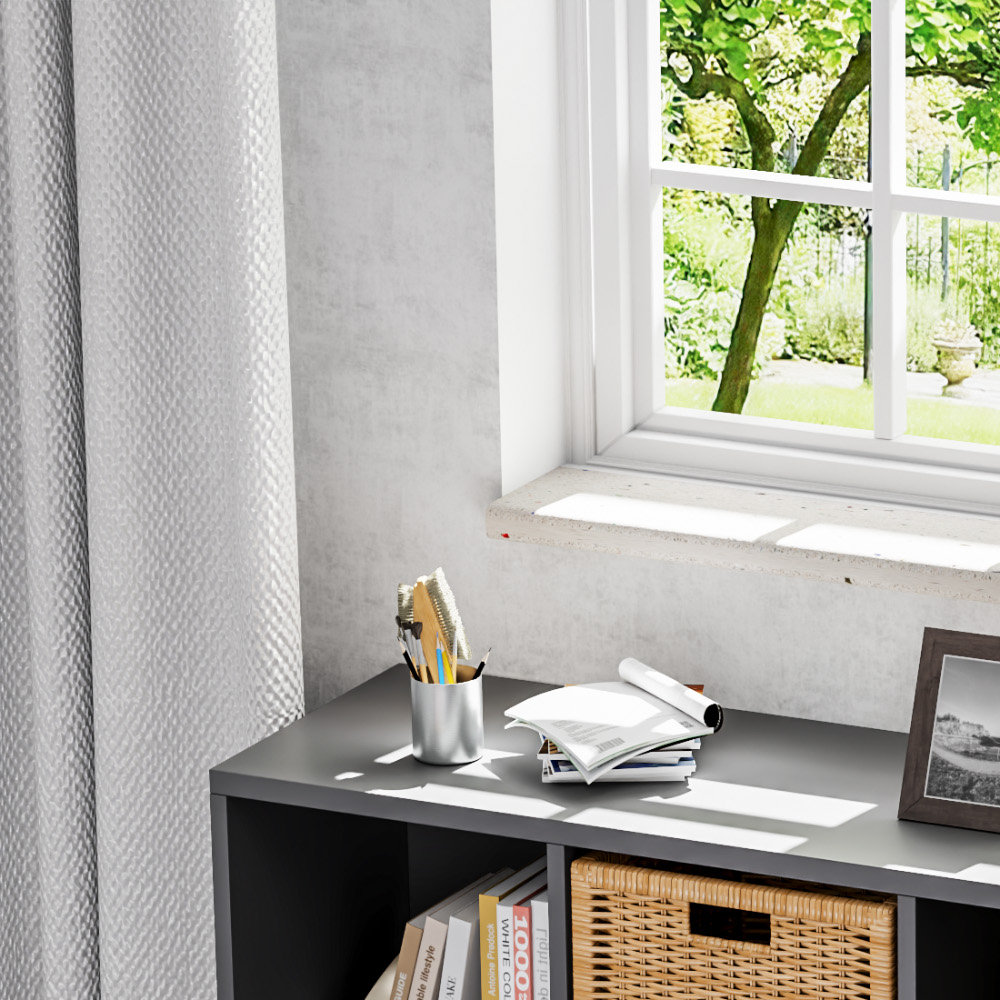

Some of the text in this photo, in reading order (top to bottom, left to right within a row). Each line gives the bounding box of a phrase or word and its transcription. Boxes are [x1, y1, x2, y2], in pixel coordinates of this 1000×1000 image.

[420, 945, 435, 982] lifestyle
[486, 923, 497, 997] Antoine Predock
[501, 918, 511, 967] WHITE
[514, 915, 530, 991] 1000
